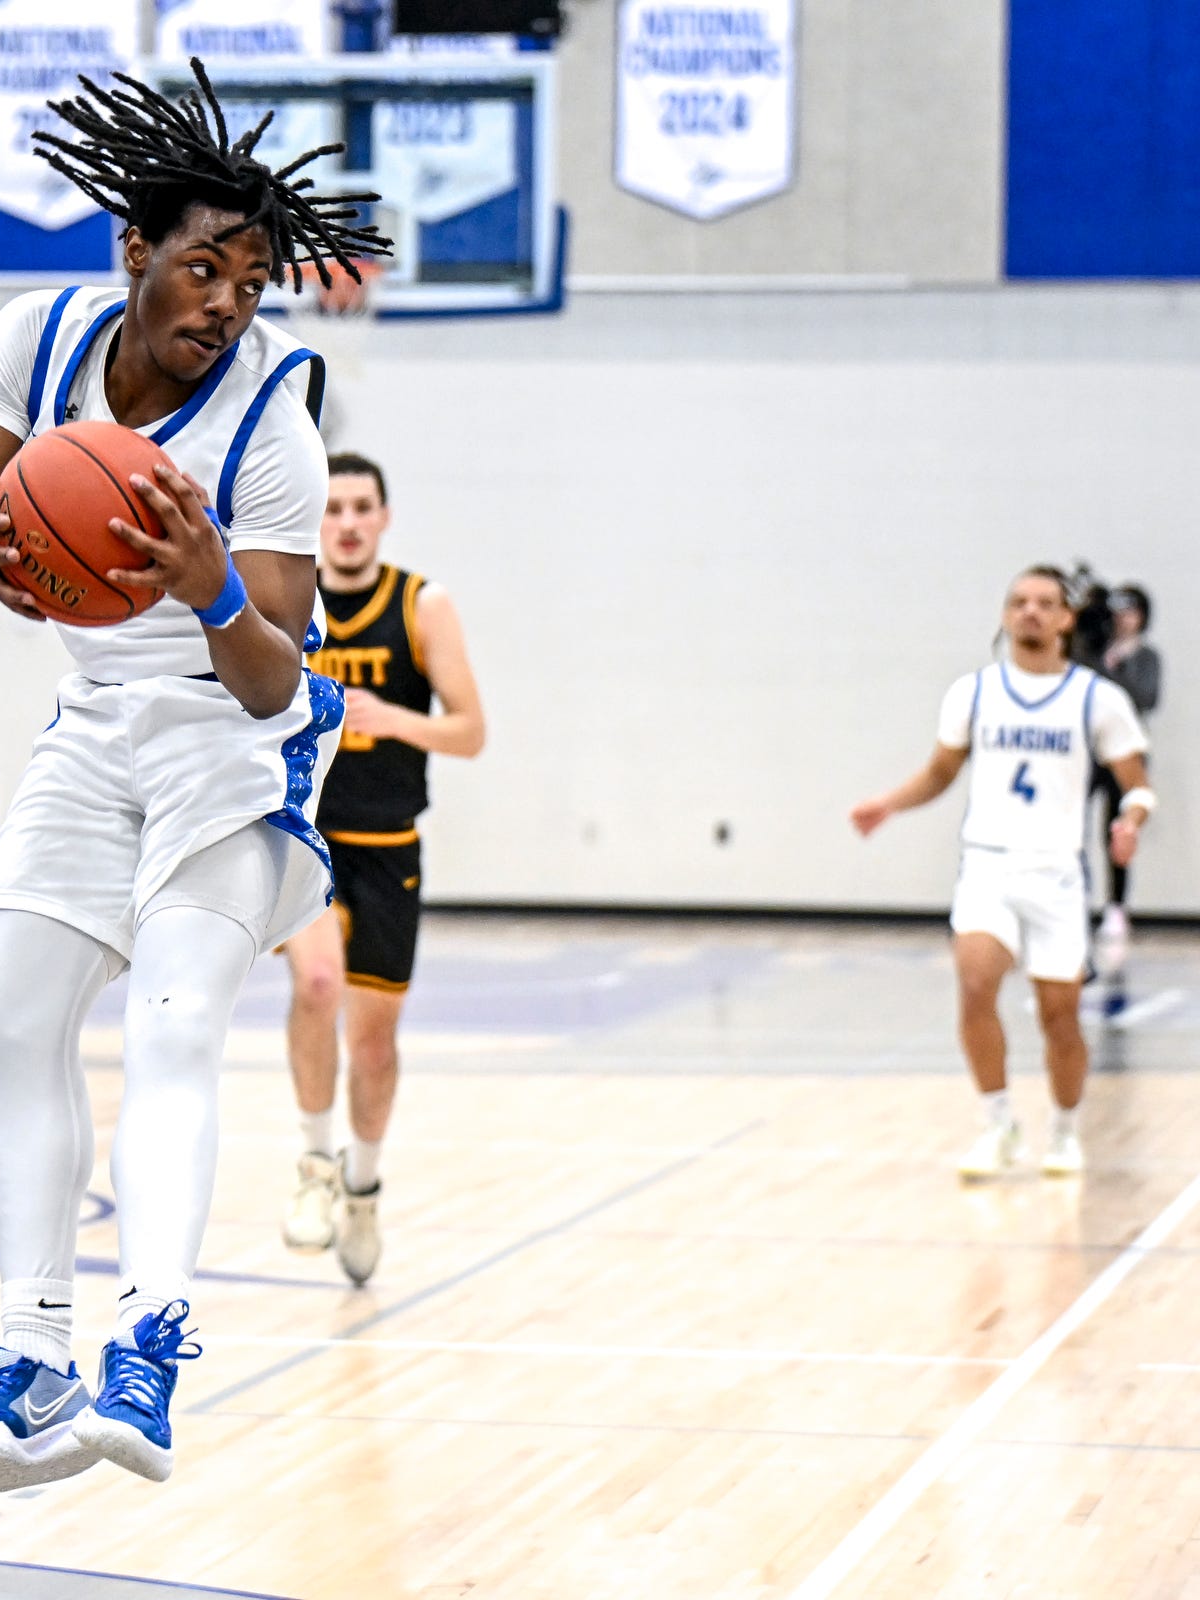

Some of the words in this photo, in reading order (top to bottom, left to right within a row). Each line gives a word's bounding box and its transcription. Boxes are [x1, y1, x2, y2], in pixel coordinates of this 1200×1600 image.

[642, 9, 764, 39] NATIONAL
[626, 44, 781, 76] CHAMPIONS
[660, 90, 748, 135] 2024
[982, 726, 1070, 753] LANSING
[1010, 761, 1035, 804] 4
